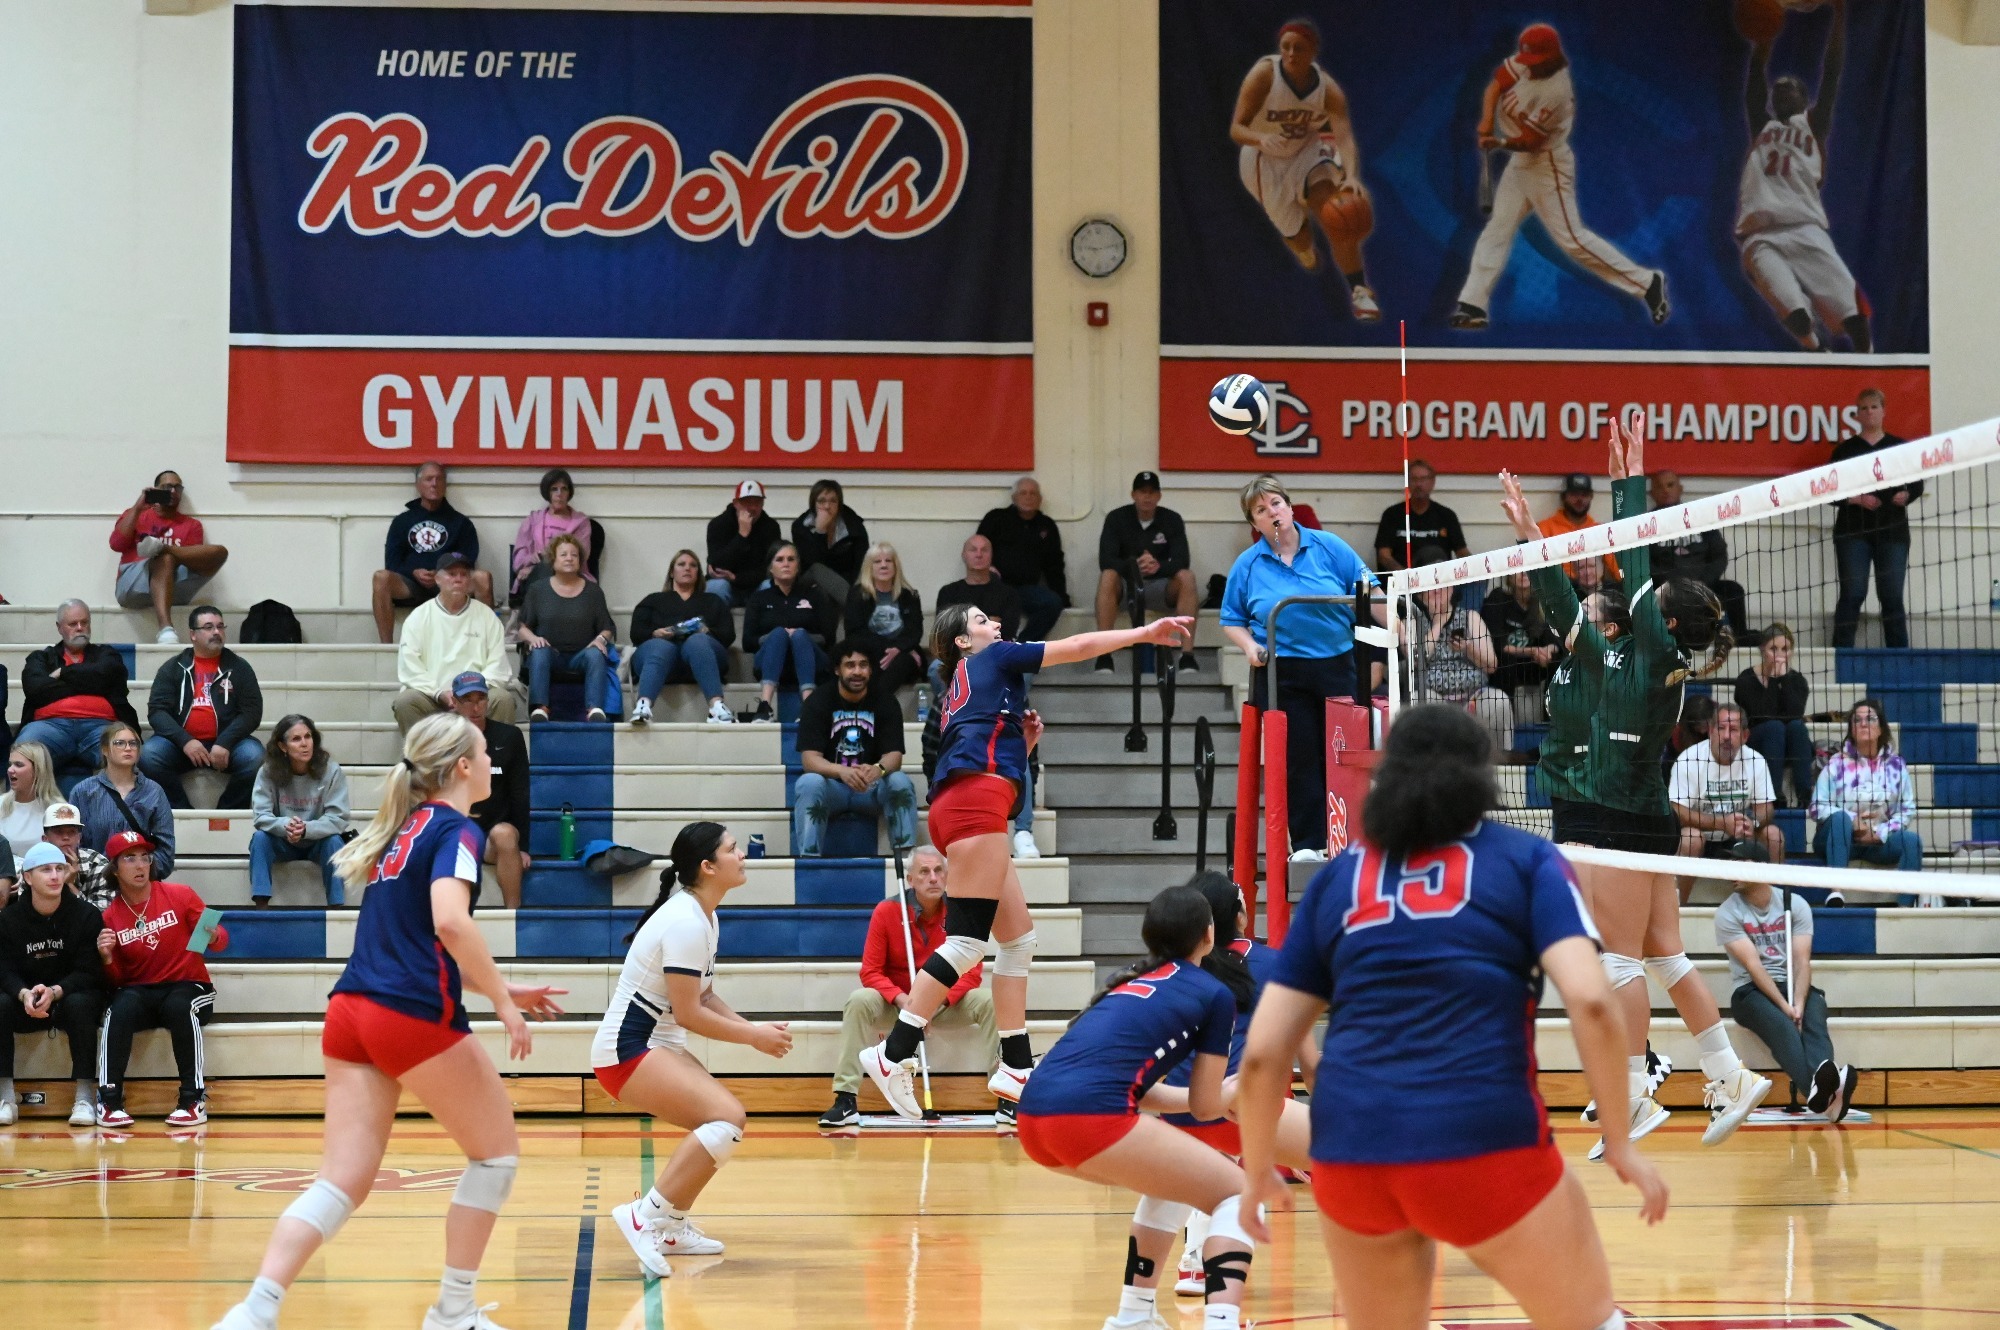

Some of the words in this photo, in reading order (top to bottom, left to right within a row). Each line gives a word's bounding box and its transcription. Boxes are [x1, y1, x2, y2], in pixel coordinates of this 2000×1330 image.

[377, 50, 468, 78] HOME
[475, 51, 513, 78] OF
[520, 52, 577, 79] THE
[298, 112, 551, 239] Red
[540, 73, 969, 247] Devils
[362, 373, 905, 453] GYMNASIUM
[1341, 400, 1547, 440] PROGRAM
[1559, 401, 1609, 440] OF
[122, 830, 139, 844] W
[367, 807, 434, 887] 3
[26, 942, 46, 955] New
